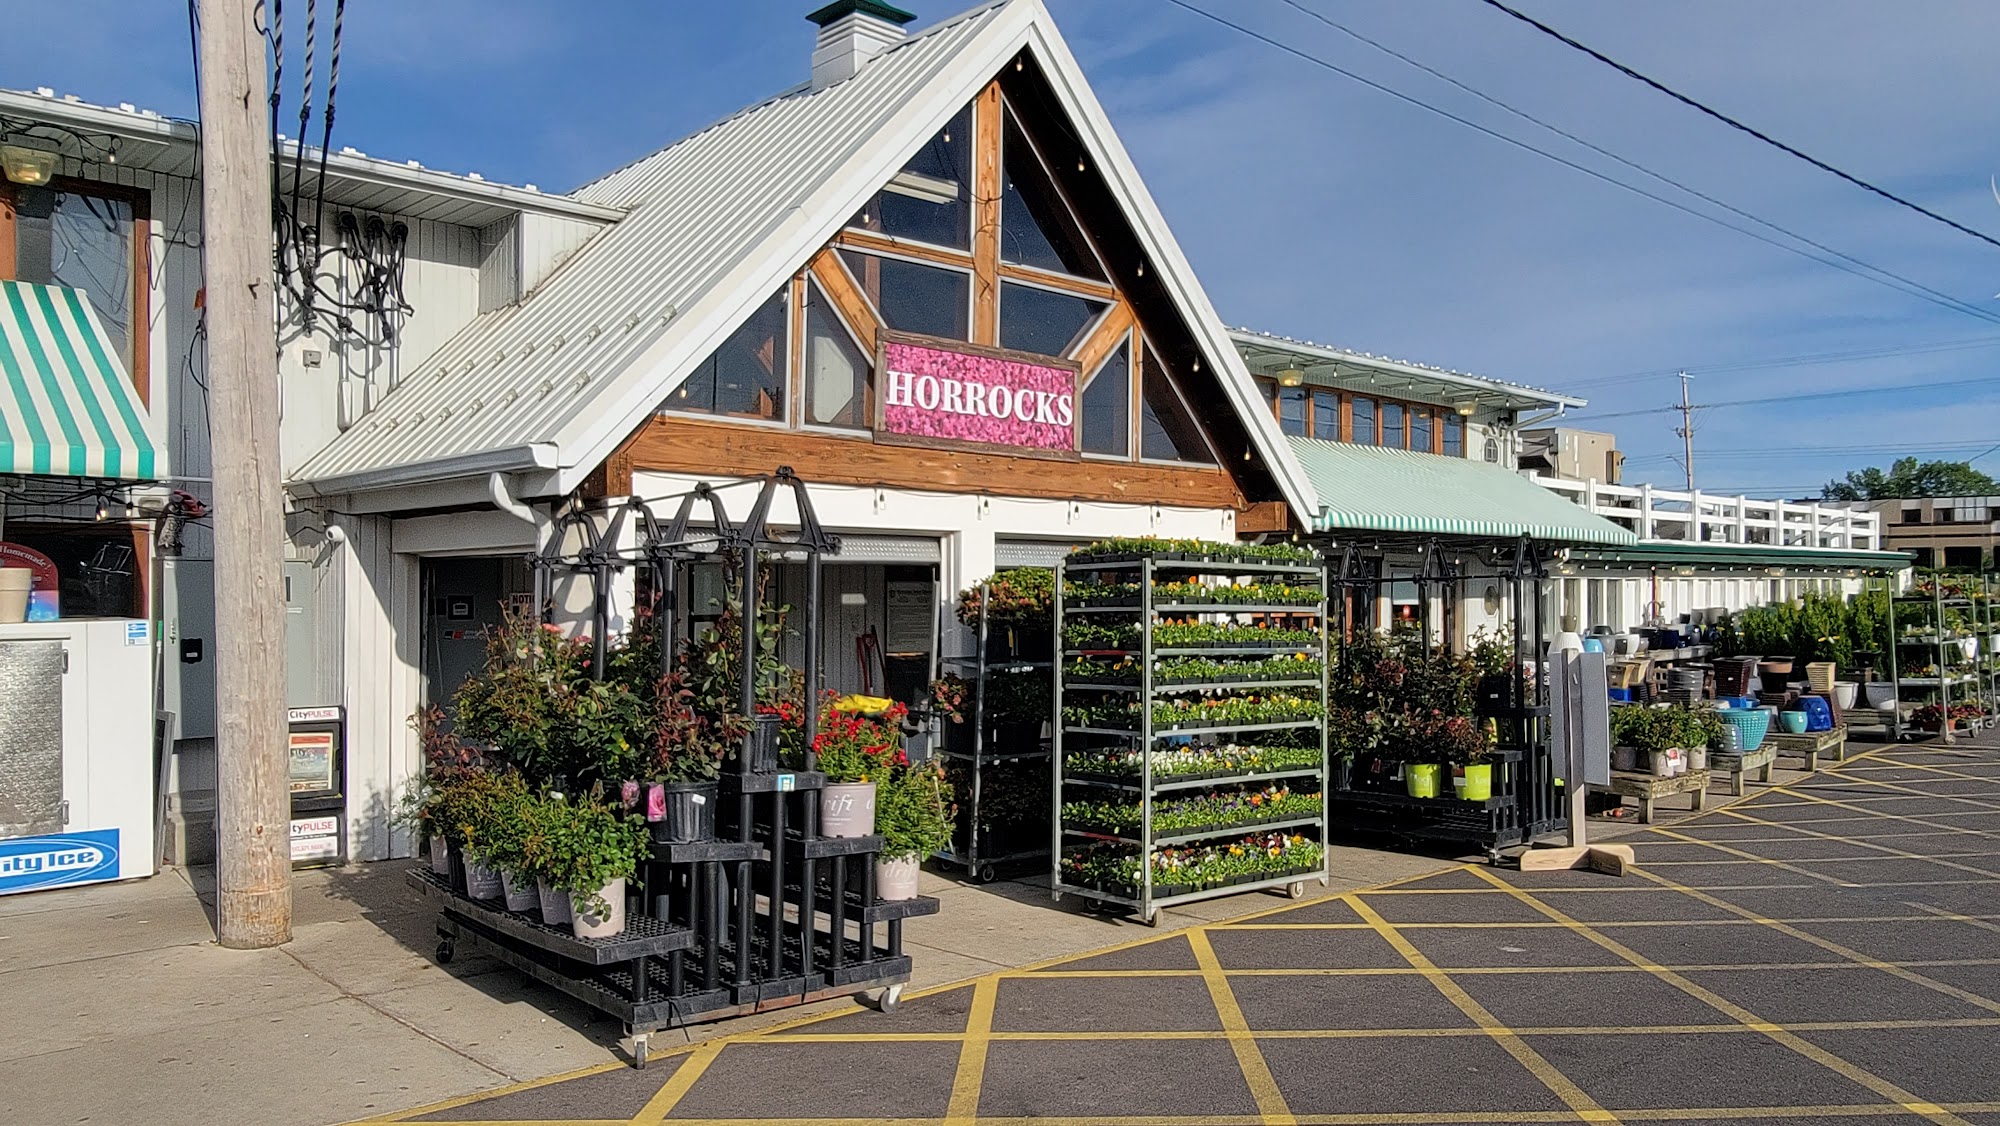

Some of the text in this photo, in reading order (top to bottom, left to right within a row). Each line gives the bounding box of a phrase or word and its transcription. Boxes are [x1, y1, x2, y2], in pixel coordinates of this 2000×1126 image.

[886, 370, 1073, 426] HORROCKS
[512, 595, 535, 604] NOTI
[823, 794, 854, 816] rift
[292, 821, 333, 834] tyPULSE
[3, 852, 94, 873] ity Ice
